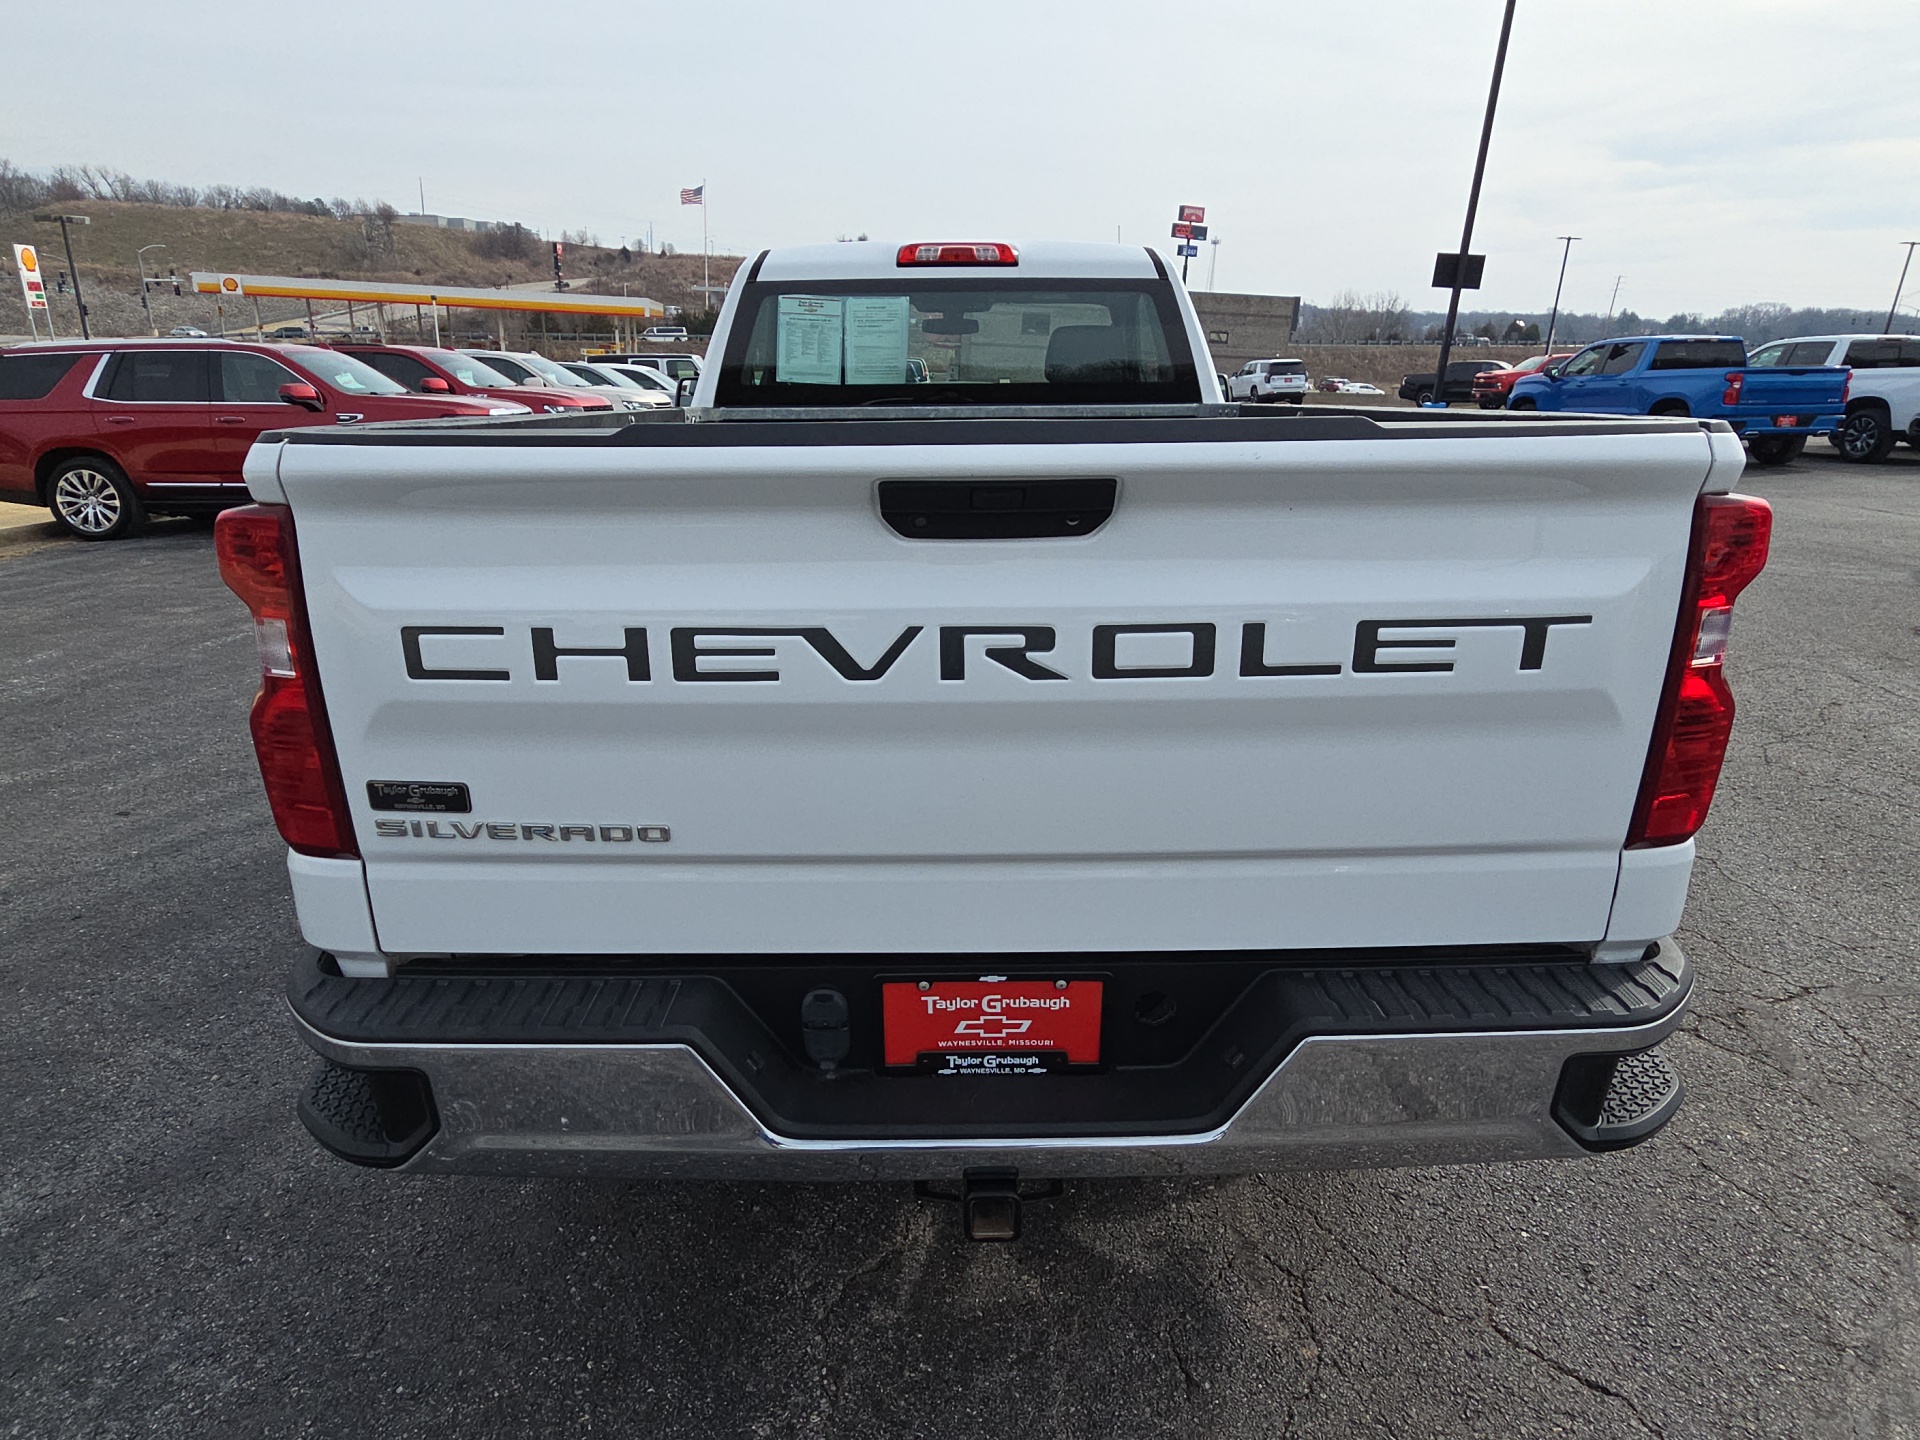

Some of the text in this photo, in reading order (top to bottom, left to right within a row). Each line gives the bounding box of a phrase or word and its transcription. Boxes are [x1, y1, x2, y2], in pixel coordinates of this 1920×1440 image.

[400, 615, 1593, 682] CHEVROLET
[374, 783, 458, 798] Taylor Grubaugh
[374, 818, 671, 843] SILVERADO
[921, 995, 1070, 1014] Taylor Grubaugh
[946, 1055, 1038, 1068] Taylor Grubaugh
